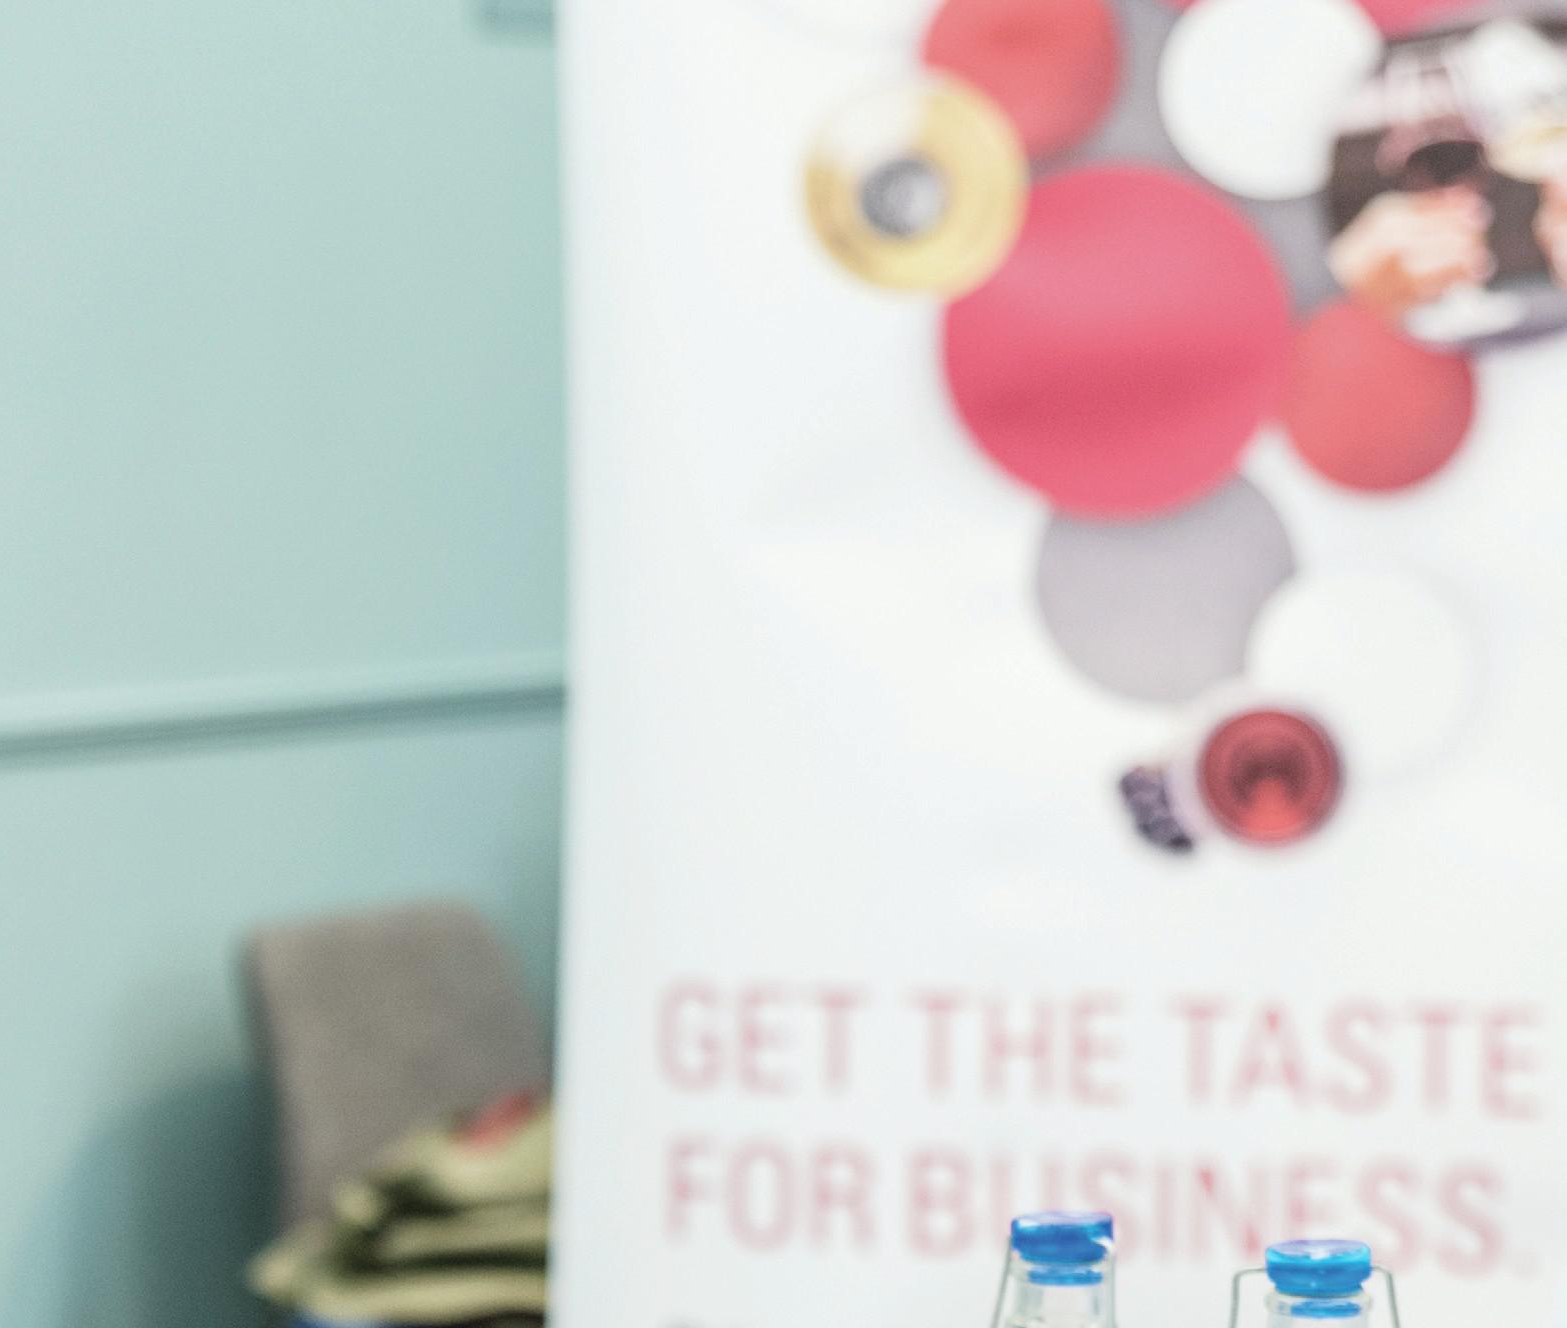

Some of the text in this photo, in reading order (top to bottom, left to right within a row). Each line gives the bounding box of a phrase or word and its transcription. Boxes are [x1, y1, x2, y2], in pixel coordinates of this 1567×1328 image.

[656, 979, 1543, 1118] GET THE TASTE
[662, 1134, 876, 1251] FOR
